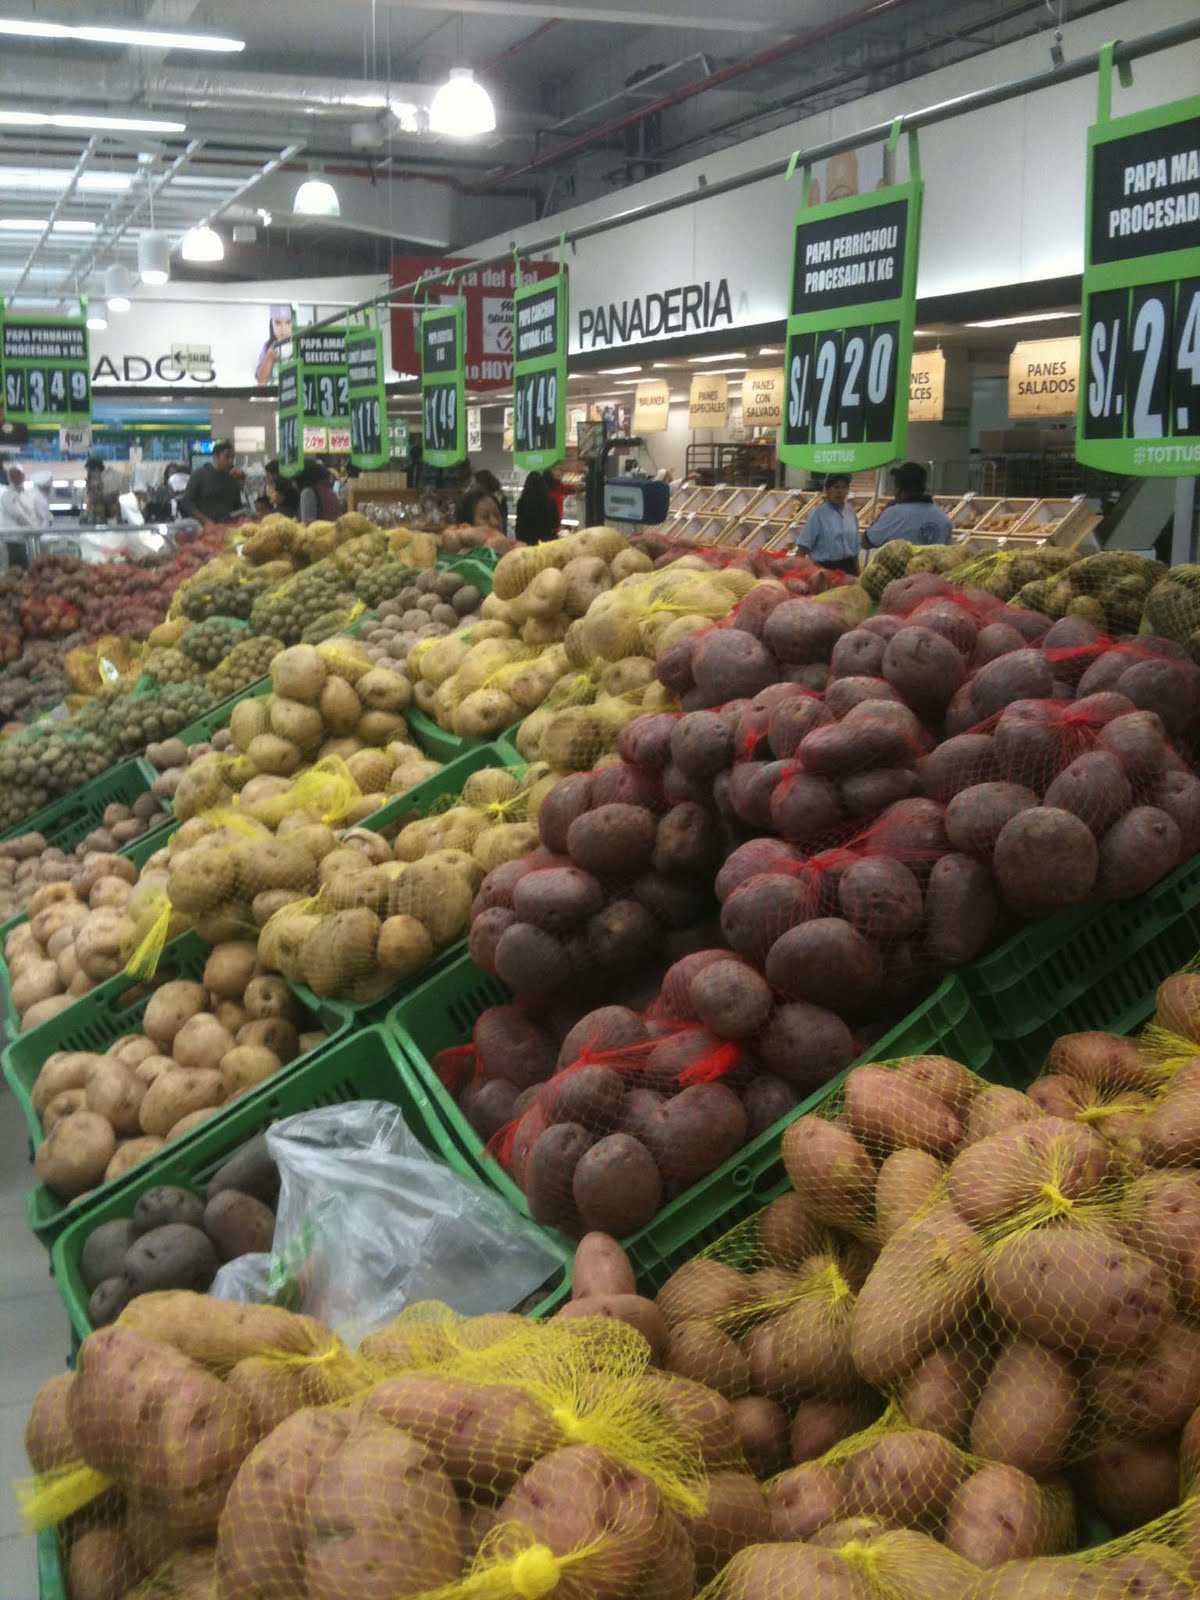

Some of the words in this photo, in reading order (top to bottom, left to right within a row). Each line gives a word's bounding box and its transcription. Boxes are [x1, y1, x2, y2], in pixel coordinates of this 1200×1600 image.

[1124, 157, 1168, 196] PAPA
[805, 240, 832, 266] PAPA
[832, 225, 898, 260] PERRICHOLI
[482, 269, 506, 288] del
[804, 262, 866, 294] PROCESADA
[867, 260, 876, 283] X
[877, 257, 894, 281] KG
[578, 278, 733, 349] PANADERIA
[6, 328, 30, 342] PAPA
[301, 337, 322, 350] PAPA
[305, 351, 339, 363] SELECTA
[1027, 361, 1067, 377] PANES
[752, 379, 775, 391] PANES
[815, 333, 893, 444] 2.20
[1018, 378, 1076, 395] SALADOS
[698, 390, 718, 401] PANES
[755, 393, 770, 404] CON
[690, 402, 726, 414] ESPECIALES
[746, 405, 780, 418] SALVADO
